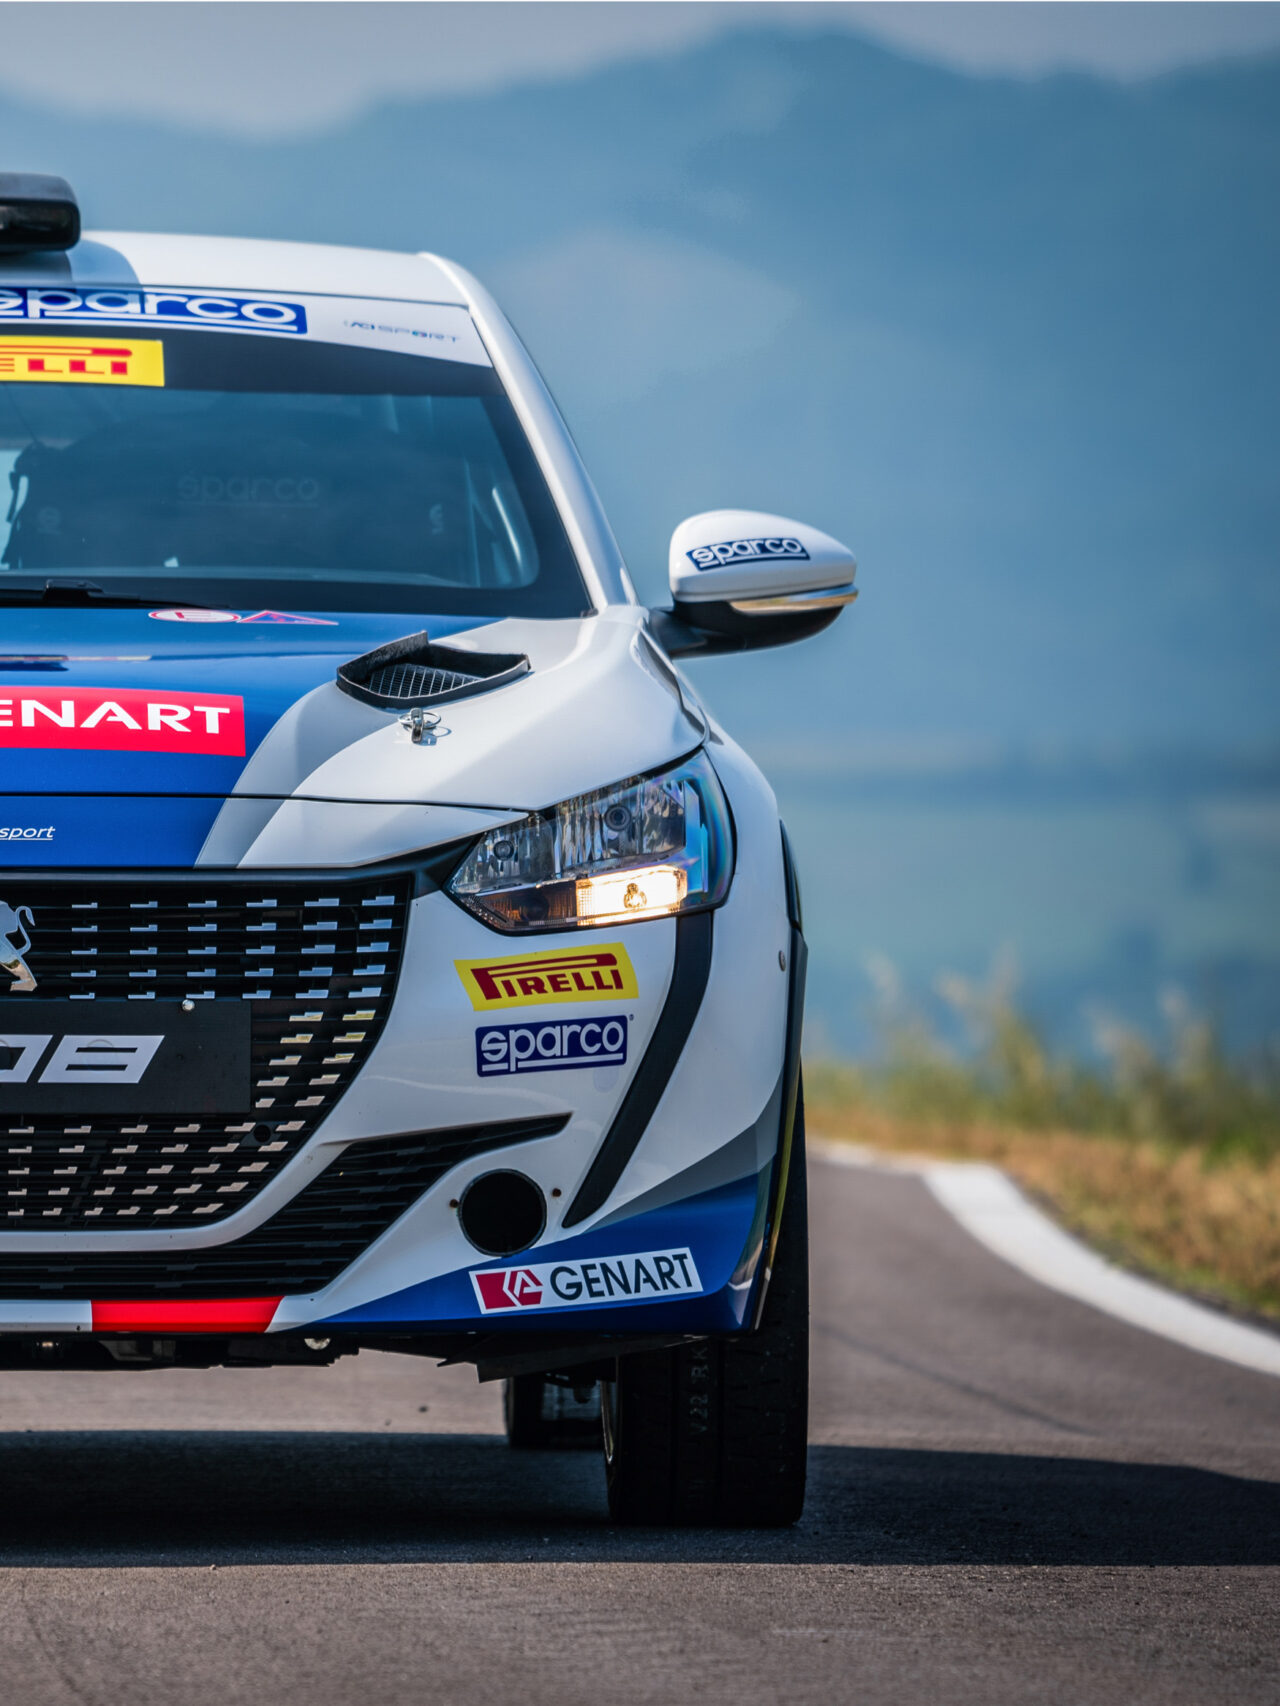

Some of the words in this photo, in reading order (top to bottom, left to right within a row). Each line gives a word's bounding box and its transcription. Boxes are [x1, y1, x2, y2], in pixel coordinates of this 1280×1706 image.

[691, 539, 802, 565] sparco
[470, 952, 624, 1001] PIRELLI
[480, 1021, 624, 1073] sparco
[550, 1253, 693, 1301] GENART
